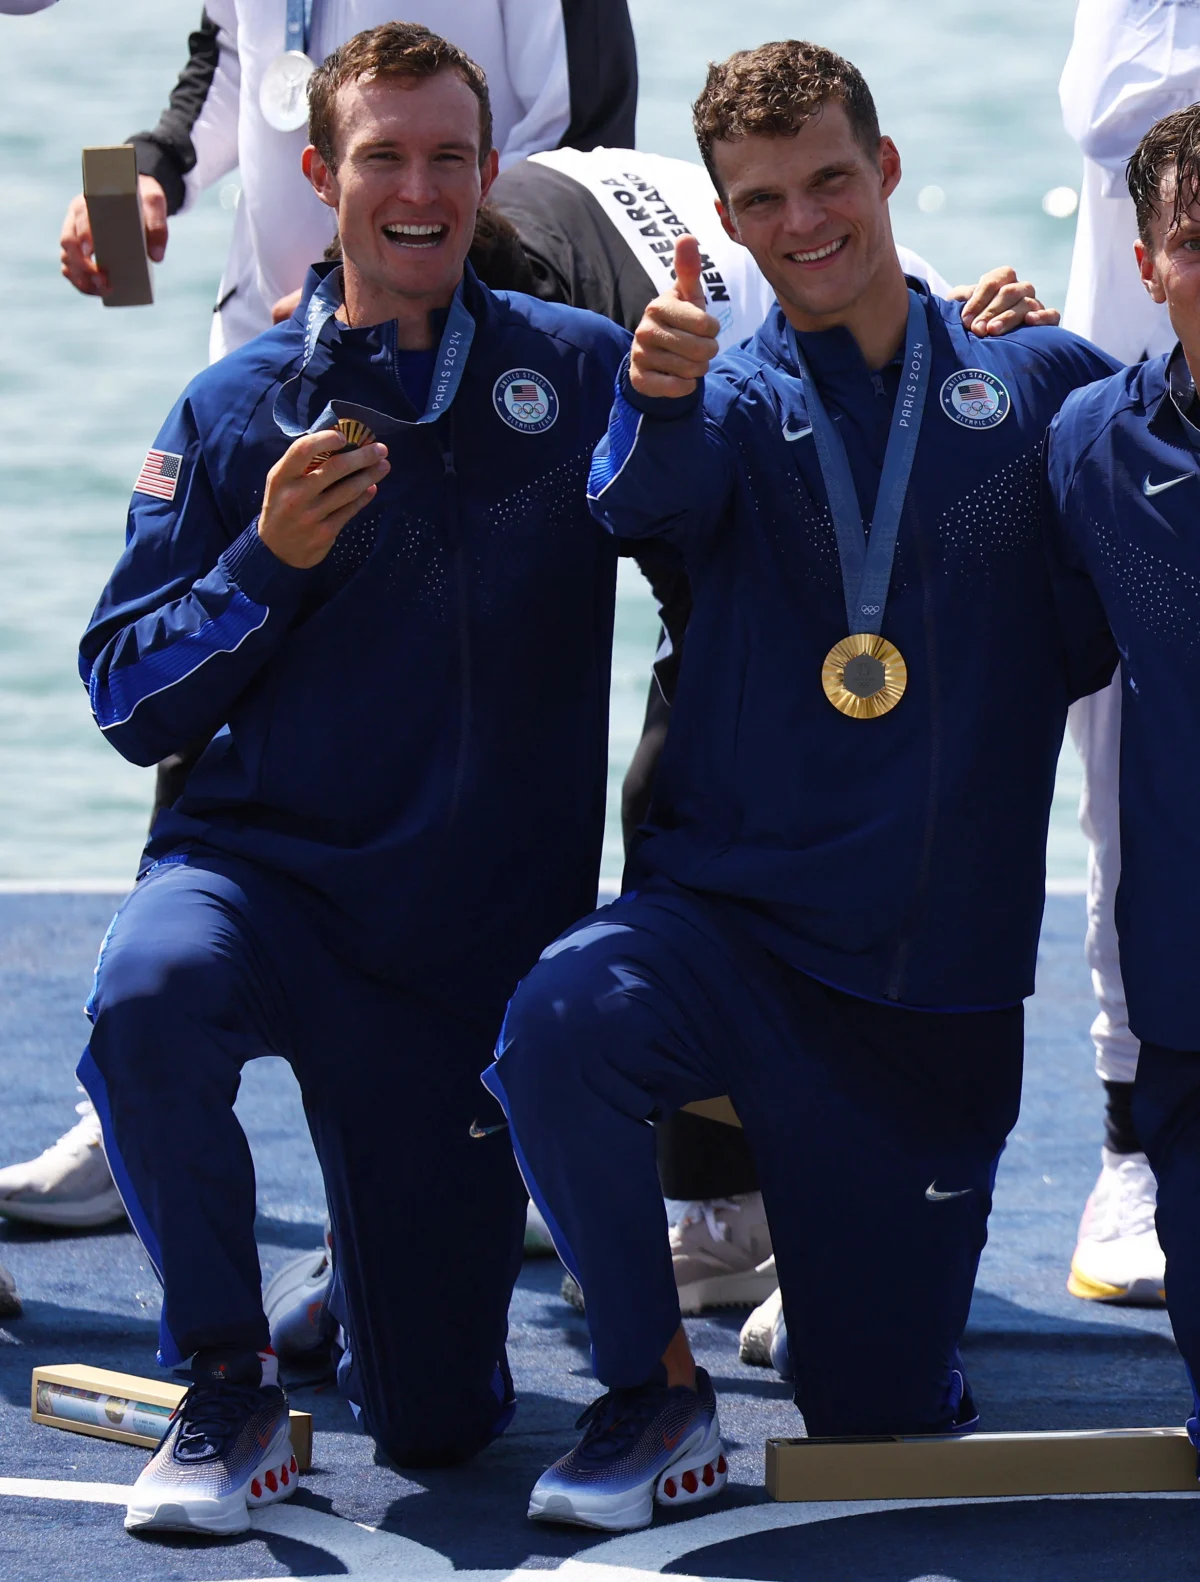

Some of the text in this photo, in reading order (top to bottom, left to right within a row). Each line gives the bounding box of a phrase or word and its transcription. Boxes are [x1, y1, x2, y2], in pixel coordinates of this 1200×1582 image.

[623, 173, 700, 246] EALAND
[444, 331, 462, 367] 2024
[909, 342, 924, 381] 2024
[499, 372, 547, 389] UNITED STATES
[946, 372, 996, 391] UNITED STATES
[506, 414, 553, 431] OLYMPIC TEAM
[955, 408, 1004, 426] OLYMPIC TEAM
